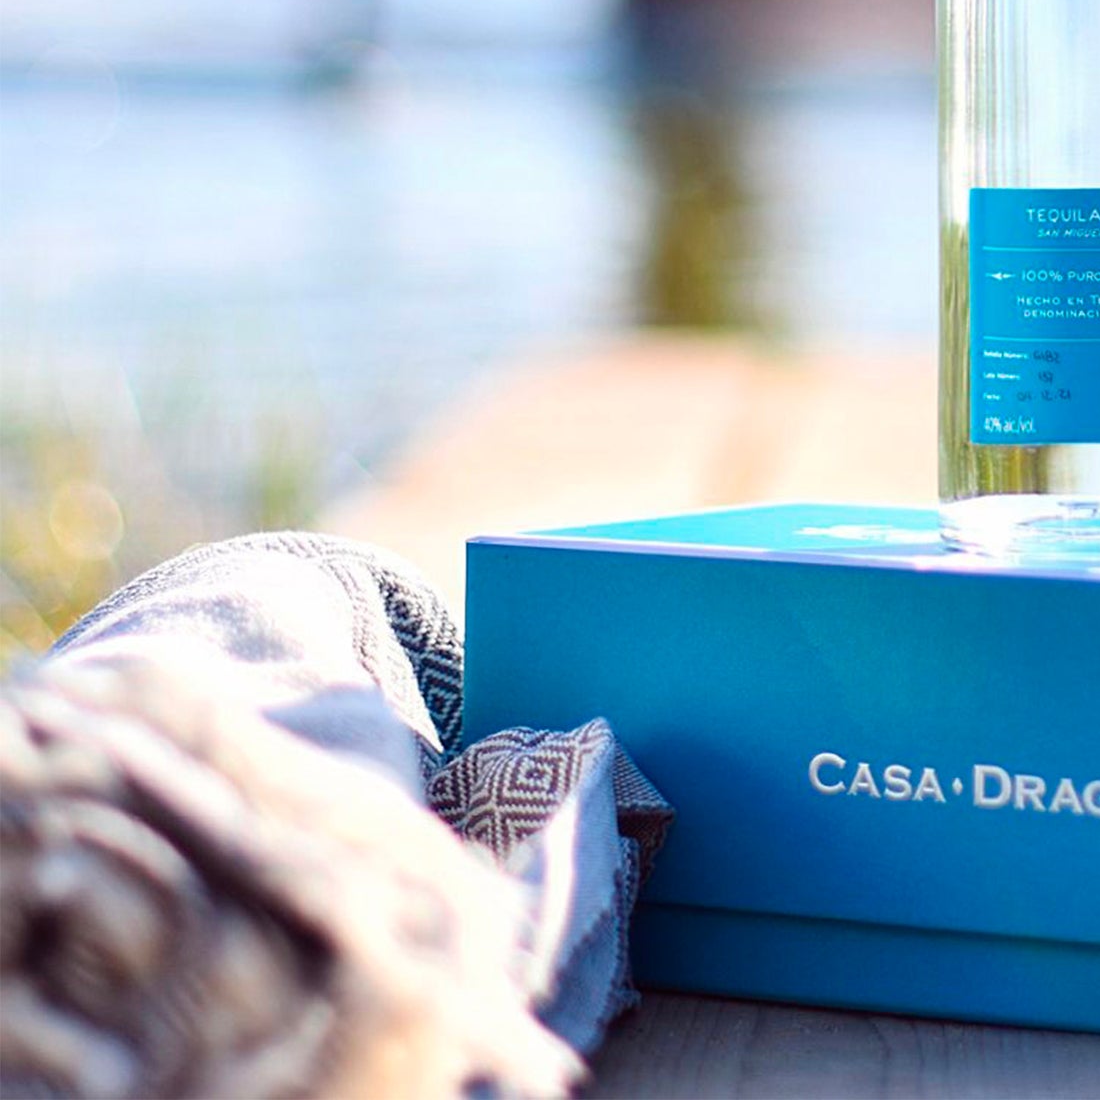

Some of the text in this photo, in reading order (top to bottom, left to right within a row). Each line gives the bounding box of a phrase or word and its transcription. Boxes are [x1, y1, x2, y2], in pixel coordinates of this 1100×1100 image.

[1037, 228, 1059, 238] SAN
[1022, 269, 1063, 282] 100%
[1017, 295, 1061, 306] HECHO
[1067, 296, 1084, 306] EN
[807, 751, 948, 804] CASA
